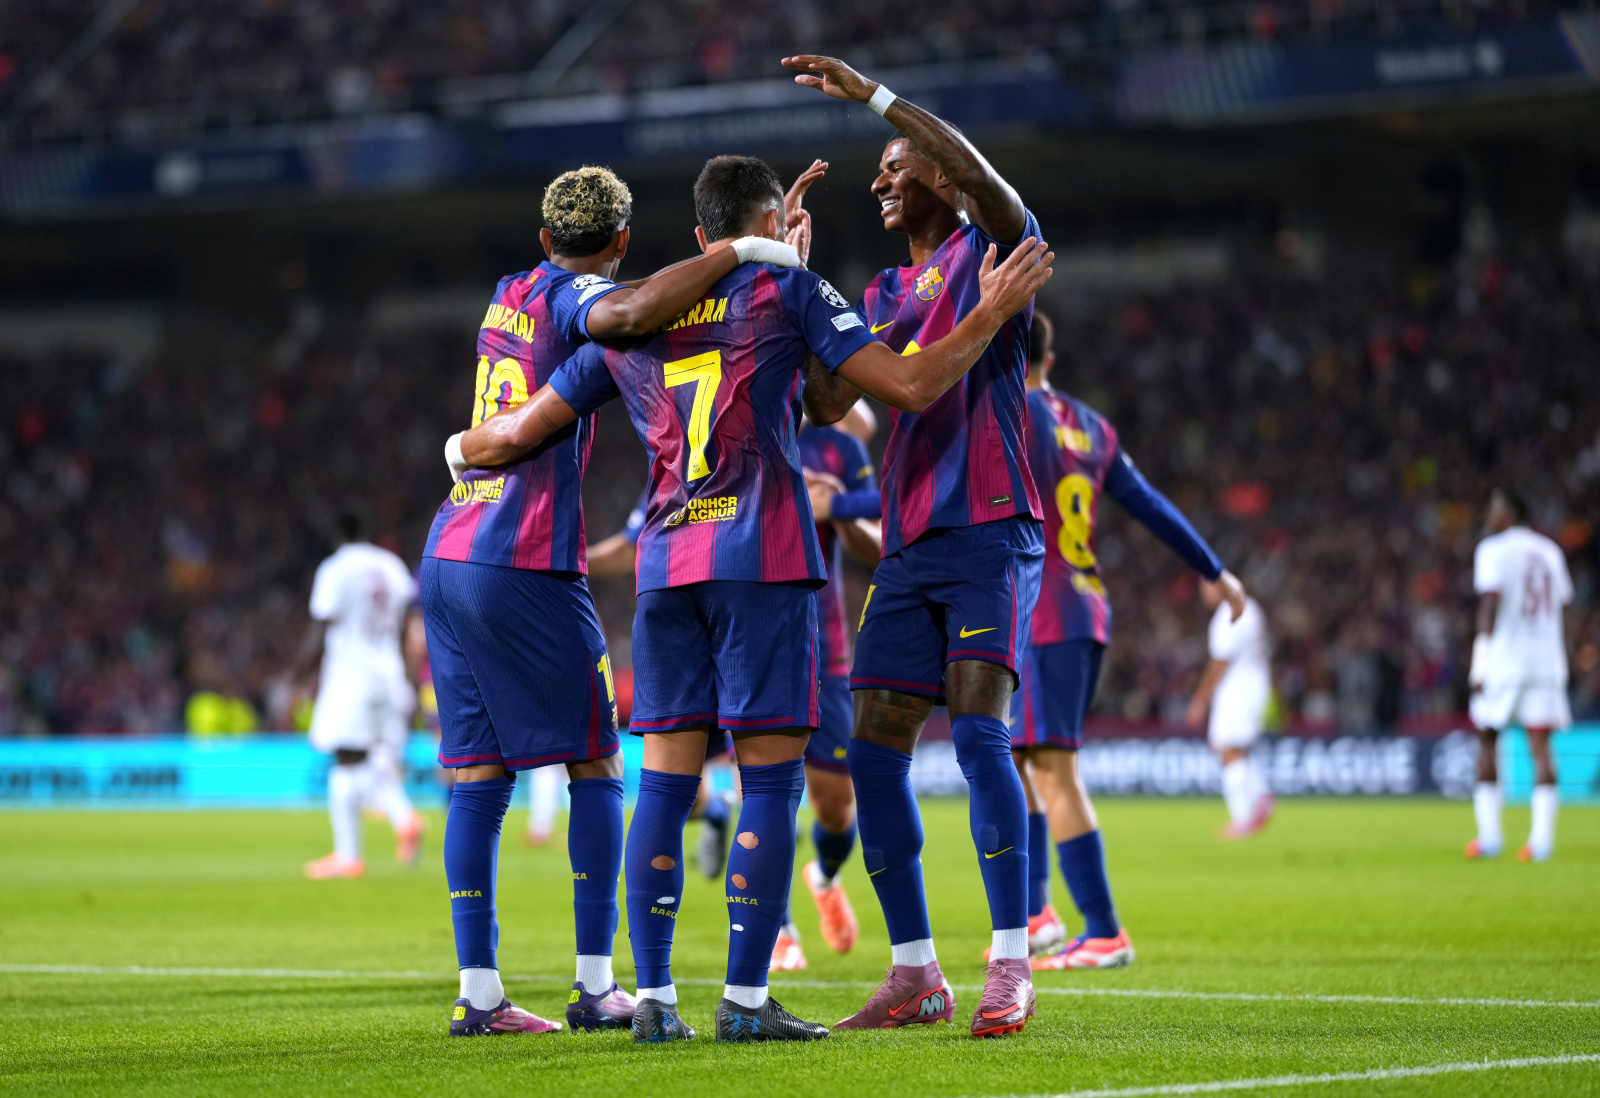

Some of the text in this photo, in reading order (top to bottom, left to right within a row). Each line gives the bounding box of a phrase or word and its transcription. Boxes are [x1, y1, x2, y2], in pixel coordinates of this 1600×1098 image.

[471, 355, 529, 429] 10
[664, 350, 722, 482] 7
[688, 497, 737, 510] UNHCR
[688, 507, 736, 520] ACNUR
[1056, 473, 1096, 569] 8
